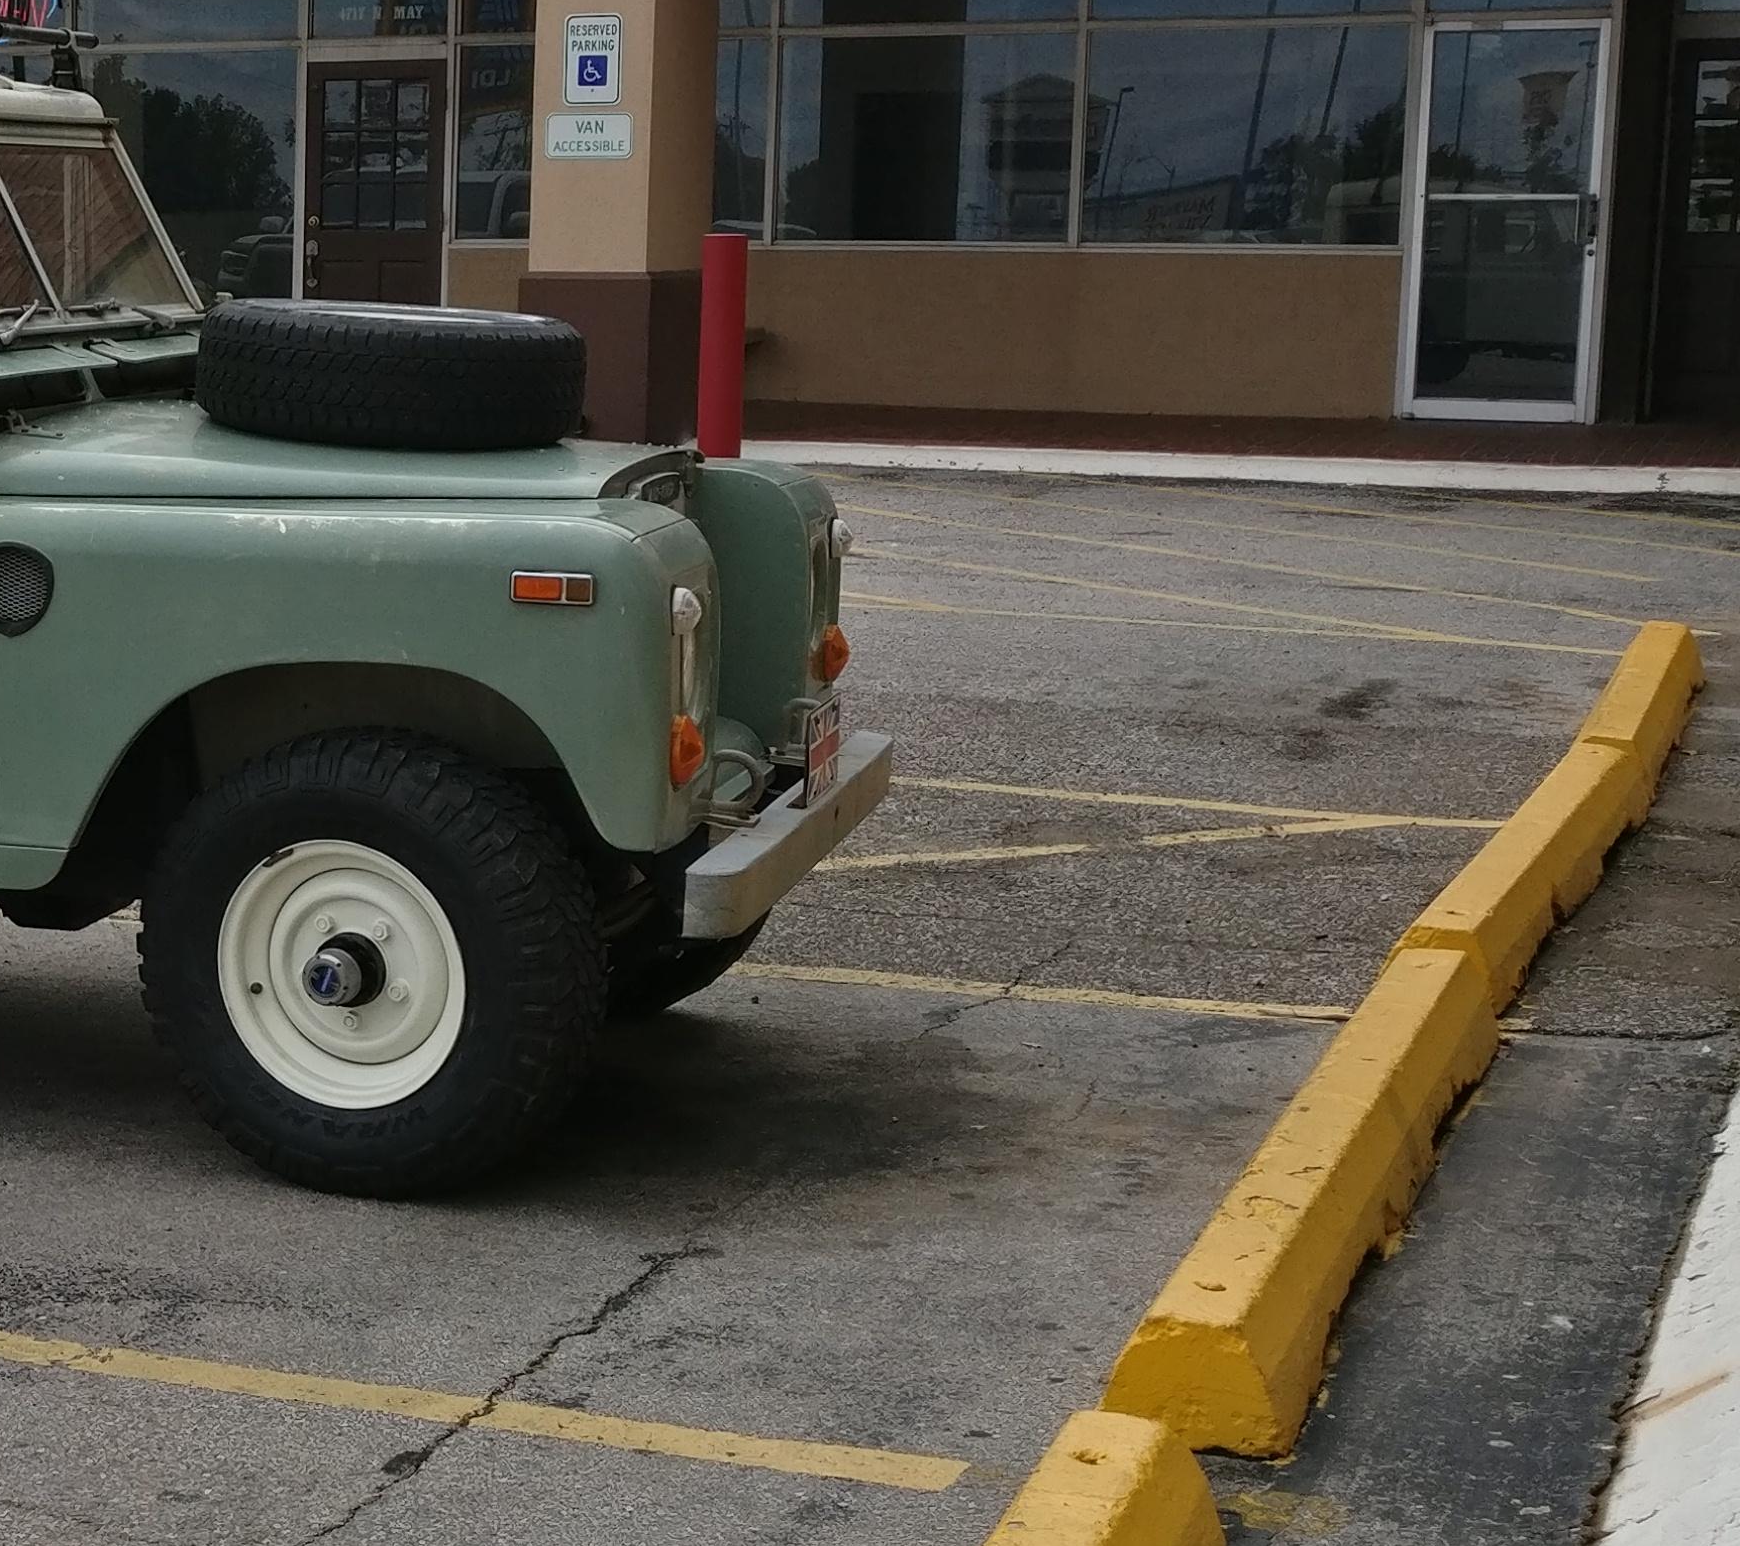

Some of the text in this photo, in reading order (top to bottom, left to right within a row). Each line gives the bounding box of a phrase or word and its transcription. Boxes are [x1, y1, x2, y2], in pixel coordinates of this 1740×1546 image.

[393, 5, 425, 20] MAY
[569, 23, 618, 37] RESERVED
[571, 39, 615, 52] PARKING
[575, 120, 604, 134] VAN
[553, 140, 625, 152] ACCESSIBLE
